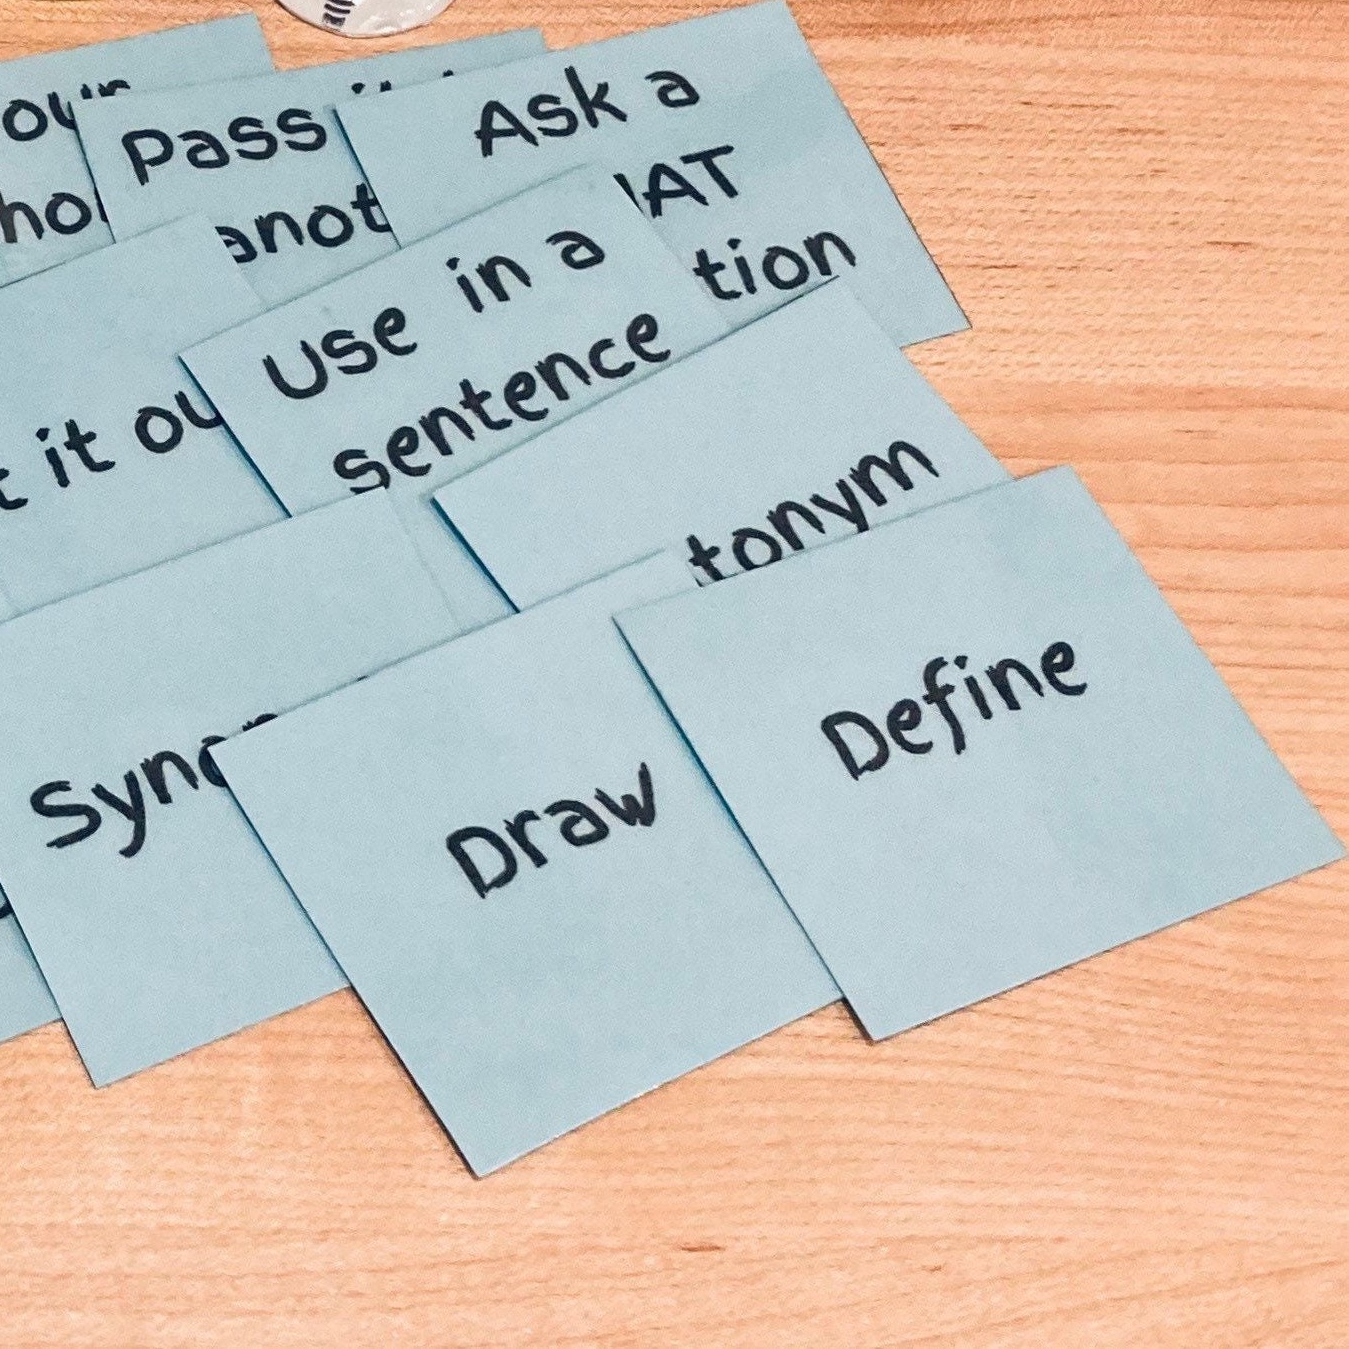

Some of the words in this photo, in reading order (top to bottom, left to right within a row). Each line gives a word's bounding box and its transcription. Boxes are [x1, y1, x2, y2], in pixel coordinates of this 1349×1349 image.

[121, 108, 328, 186] Pass
[474, 65, 628, 158] Ask
[645, 70, 700, 109] a
[613, 144, 739, 219] AT
[262, 307, 418, 400] Use
[445, 255, 532, 314] in
[545, 230, 606, 271] a
[35, 418, 117, 489] it
[333, 313, 672, 496] sentence
[685, 440, 940, 587] tonym
[819, 640, 1089, 781] Define
[29, 713, 279, 859] Syn
[445, 762, 659, 899] Draw
